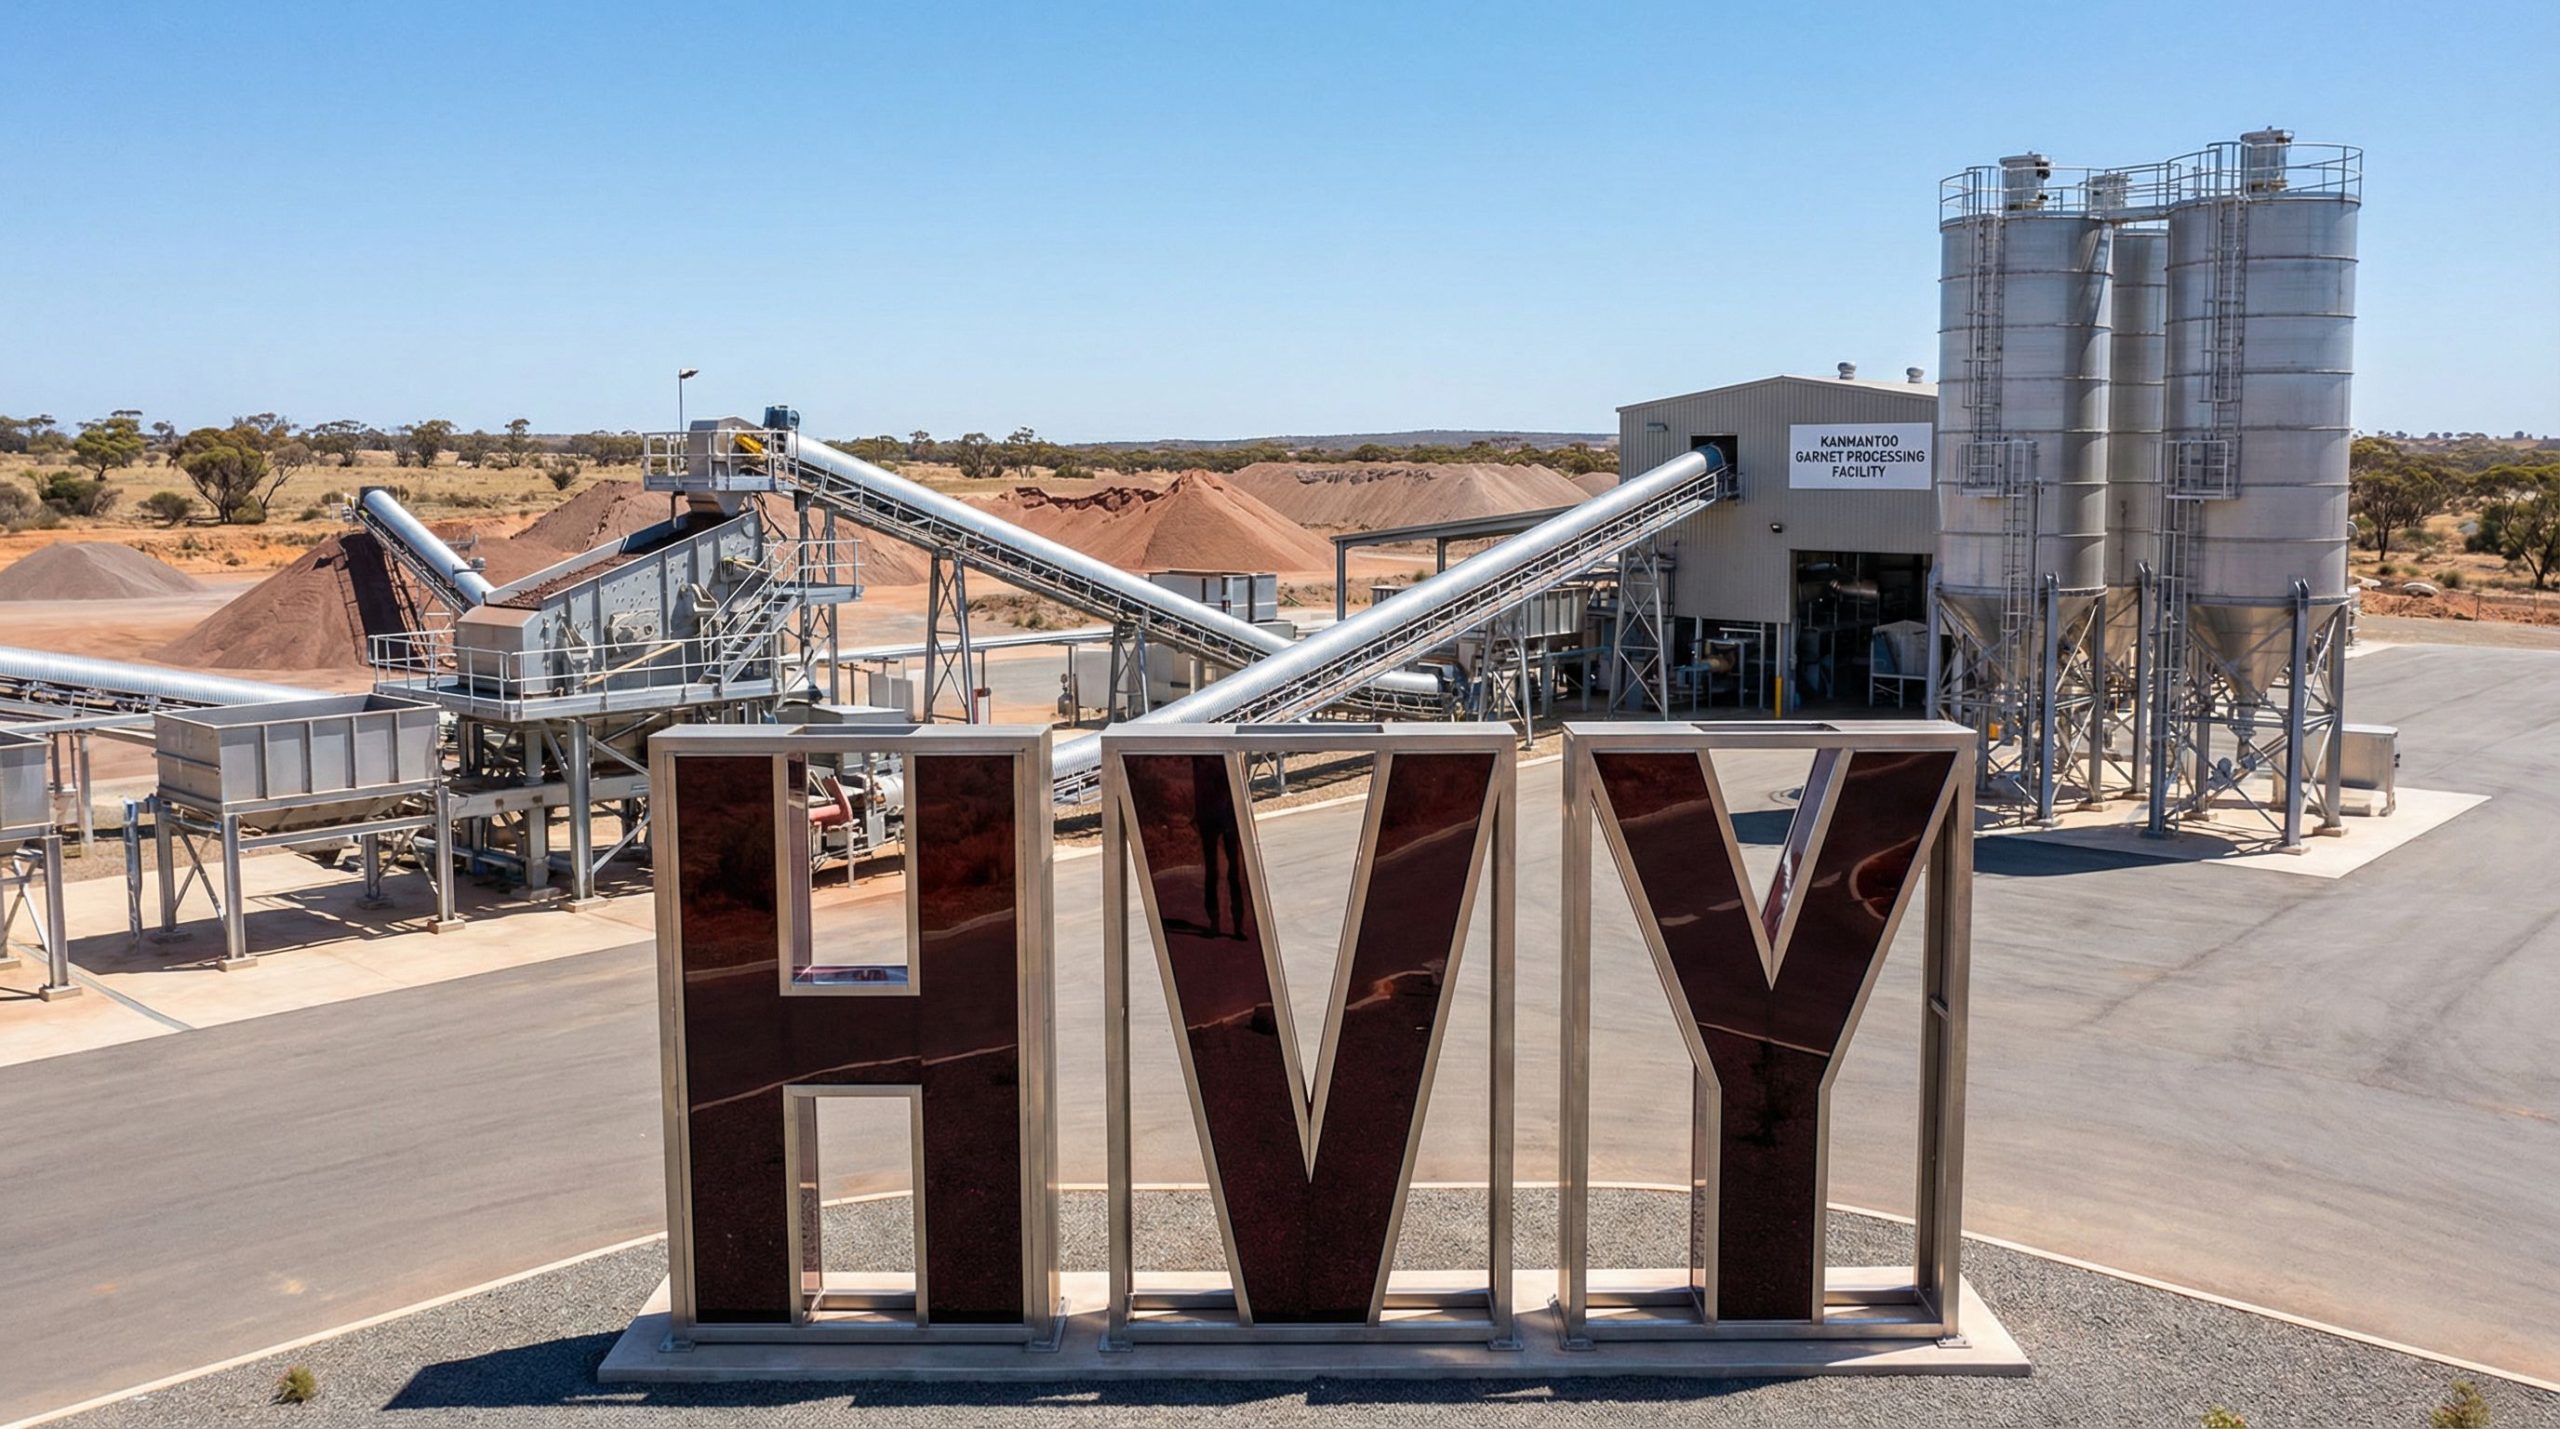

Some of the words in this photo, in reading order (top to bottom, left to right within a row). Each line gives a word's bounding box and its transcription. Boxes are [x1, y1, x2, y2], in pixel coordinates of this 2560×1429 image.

[1820, 435, 1899, 447] KANMANTOO
[1795, 451, 1843, 462] GARNET
[1846, 450, 1925, 462] PROCESSING
[1832, 466, 1886, 477] FACILITY
[672, 750, 1958, 1326] HVY
